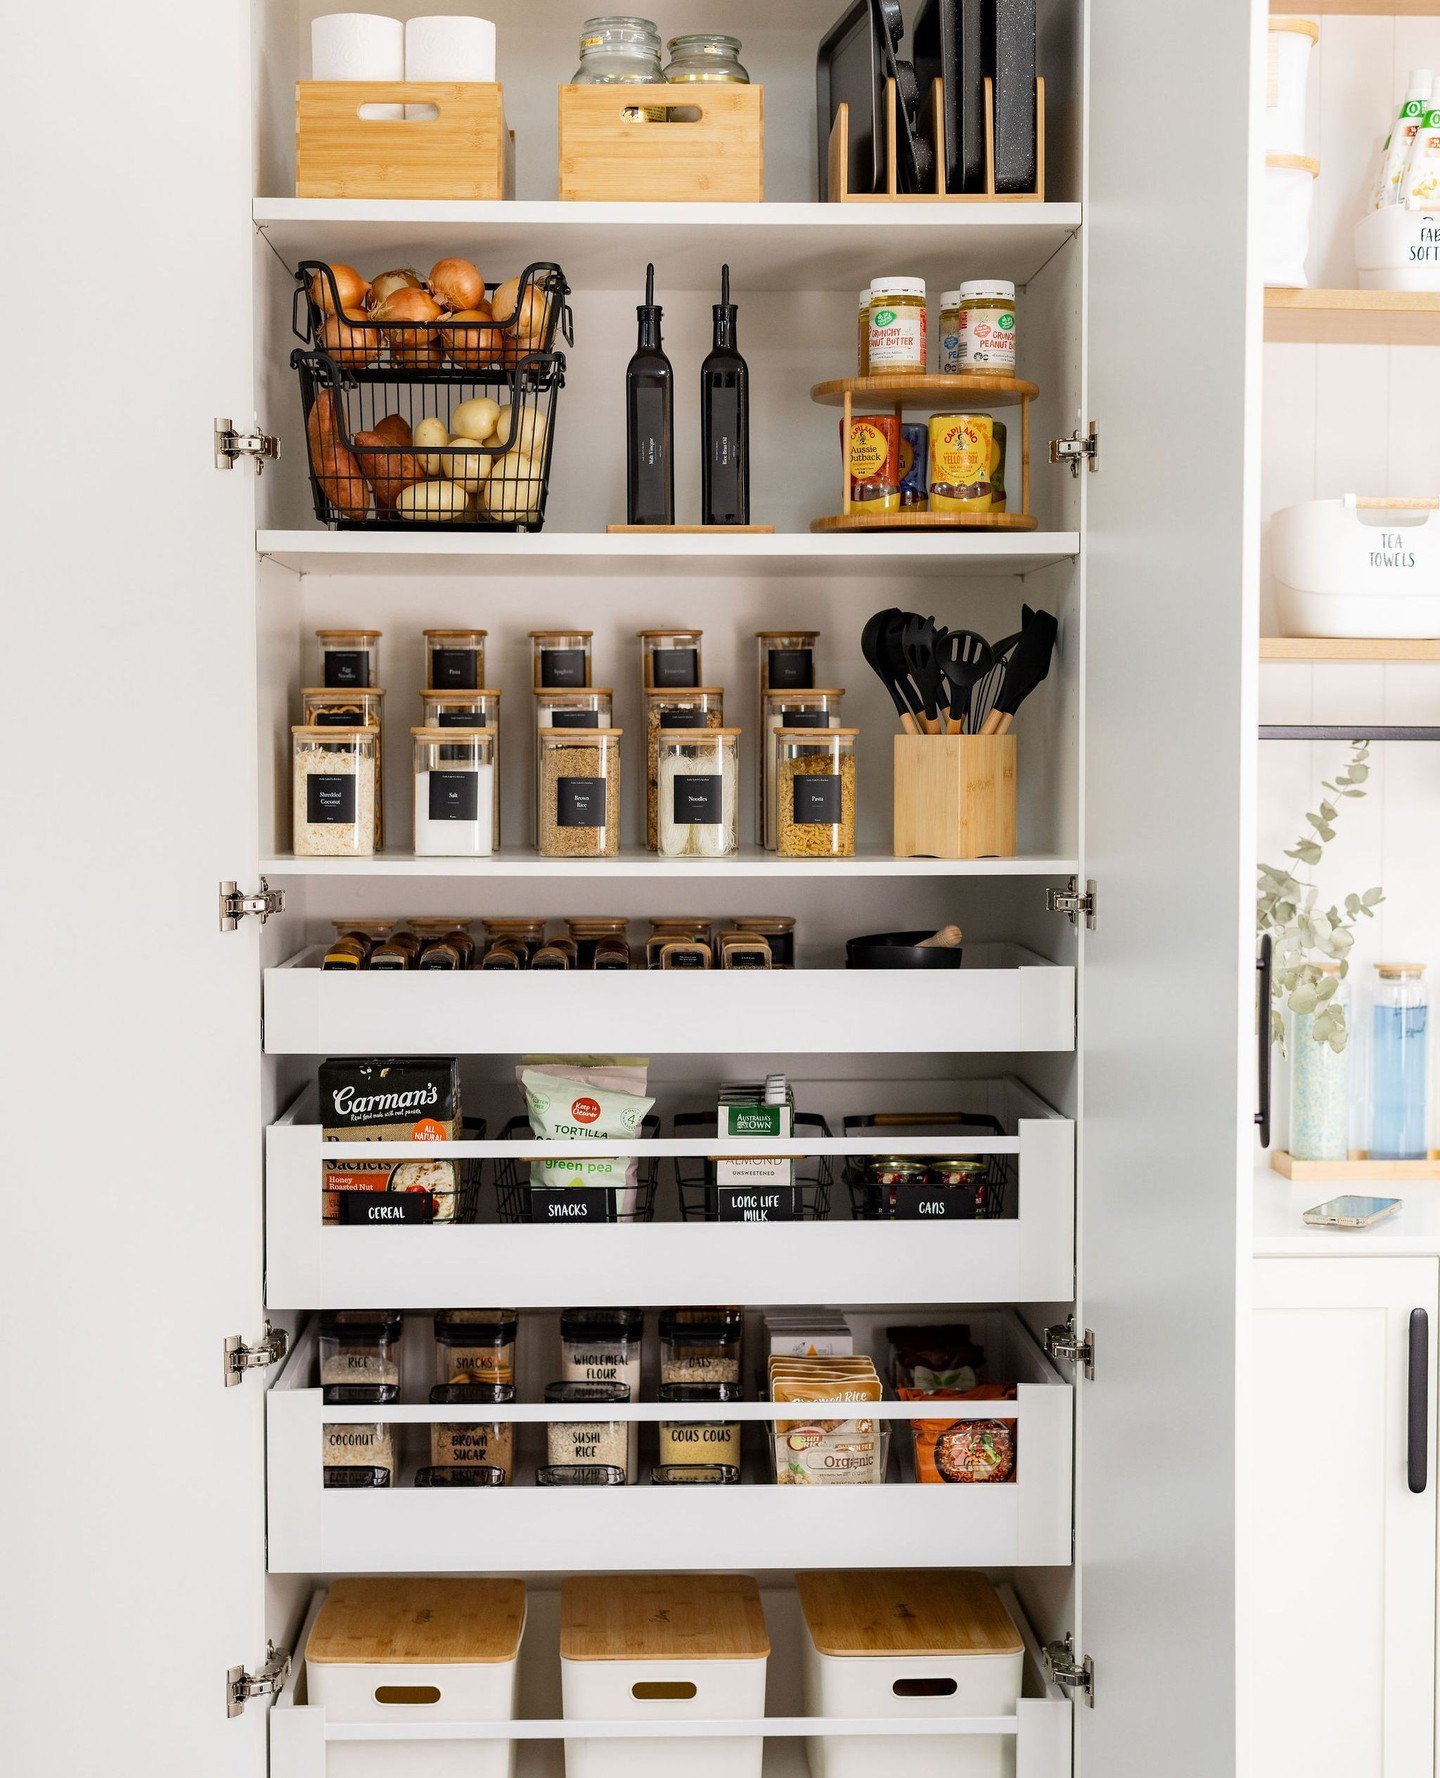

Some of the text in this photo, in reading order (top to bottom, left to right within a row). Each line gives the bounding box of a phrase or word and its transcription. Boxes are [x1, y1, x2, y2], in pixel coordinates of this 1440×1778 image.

[871, 328, 902, 338] CRUNCHY
[979, 339, 1008, 350] PEANUT
[944, 426, 978, 444] CAPILANO
[851, 445, 878, 455] Aussie
[1381, 533, 1403, 549] TEA
[1369, 551, 1415, 568] TOWELS
[333, 1082, 438, 1115] Carman's
[575, 1101, 590, 1111] Keep
[350, 1113, 362, 1122] Real
[362, 1112, 373, 1121] food
[395, 1109, 404, 1117] real
[572, 1107, 597, 1118] Cleaner
[627, 1114, 636, 1125] 4
[748, 1121, 771, 1129] OWN
[424, 1125, 436, 1134] ALL
[554, 1124, 608, 1139] TORTILLA
[545, 1159, 613, 1174] green pea
[329, 1176, 353, 1184] Honey
[329, 1183, 358, 1191] Roasted
[731, 1195, 780, 1208] LONG LIFE
[368, 1206, 406, 1220] CEREAL
[548, 1203, 588, 1217] SNACKS
[918, 1201, 945, 1215] CANS
[743, 1209, 768, 1221] MILK
[348, 1356, 369, 1368] RICE
[456, 1357, 493, 1369] SNACKS
[574, 1354, 630, 1366] WHOLEMEAL
[689, 1357, 711, 1368] OATS
[586, 1368, 617, 1380] FLOUR
[845, 1390, 868, 1402] Rice
[329, 1433, 375, 1446] COCONUT
[452, 1434, 488, 1447] BROWN
[572, 1431, 601, 1444] SUSHI
[671, 1429, 731, 1442] COUS COUS
[453, 1449, 487, 1461] SUGAR
[575, 1446, 597, 1458] RICE
[823, 1453, 874, 1469] Organic
